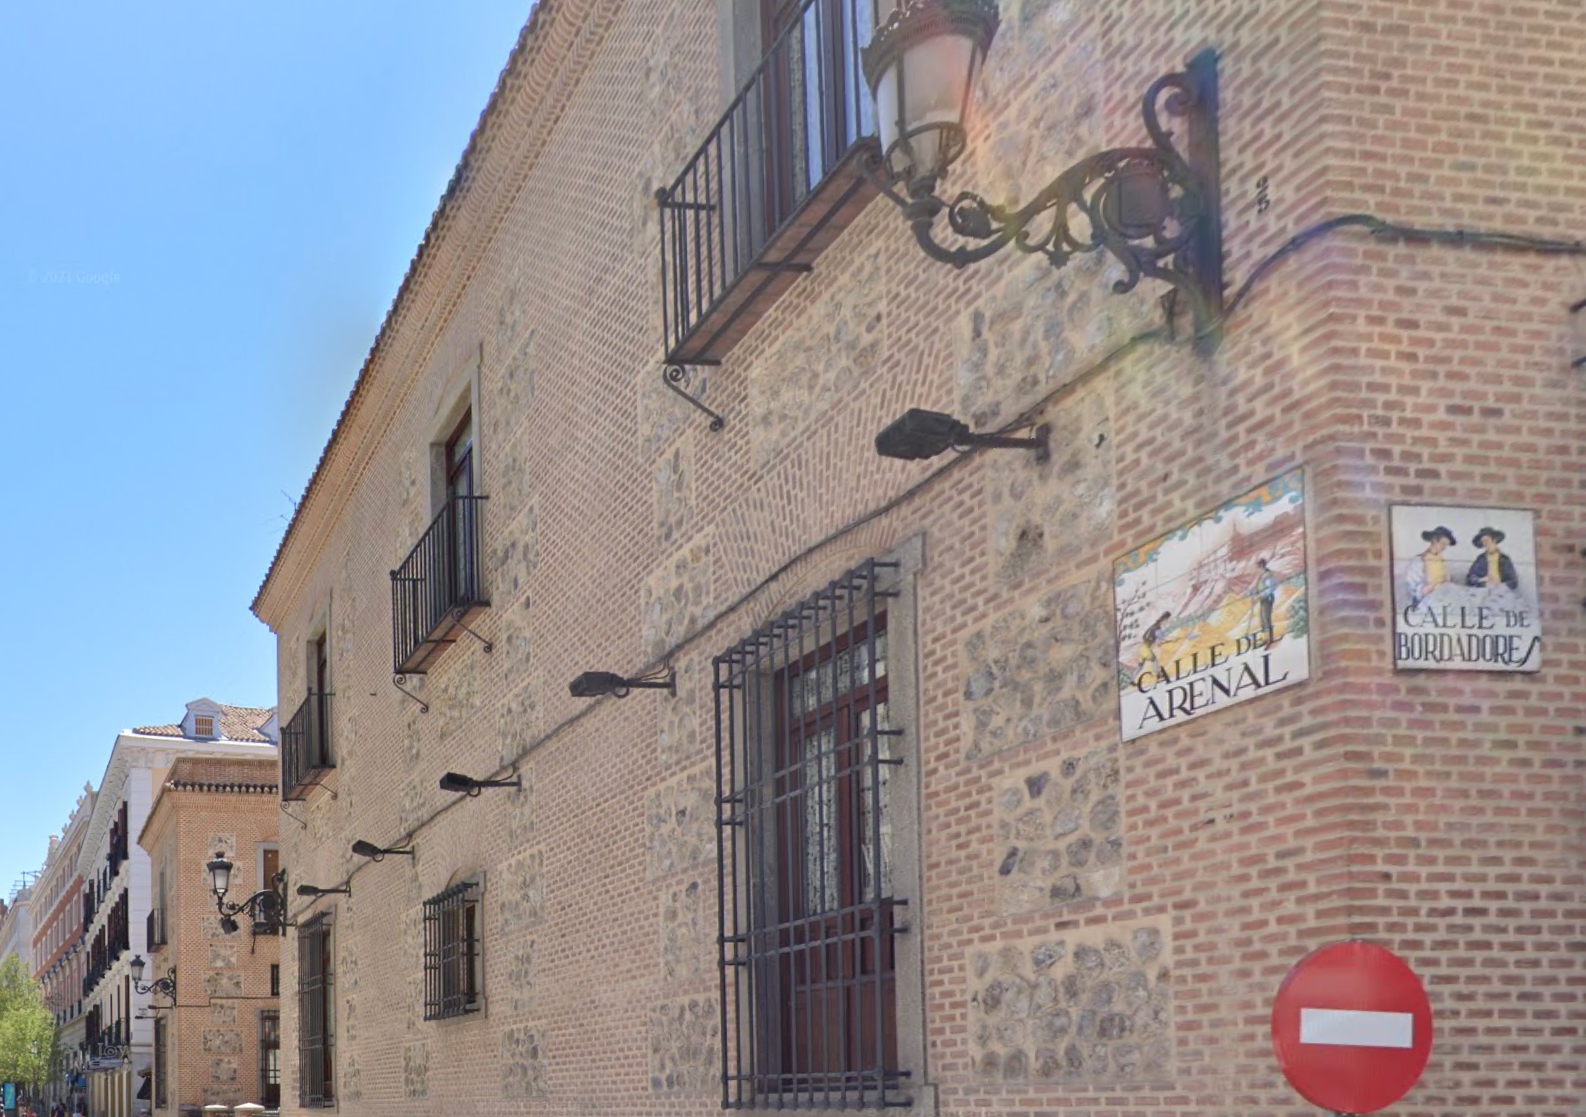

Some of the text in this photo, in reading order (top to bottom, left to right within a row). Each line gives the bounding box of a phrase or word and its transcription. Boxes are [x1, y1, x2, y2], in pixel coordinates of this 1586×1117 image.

[1403, 604, 1532, 630] CALLE DE
[1135, 624, 1284, 694] CALLE DEL
[1397, 632, 1541, 667] BORDADORES
[1137, 652, 1290, 730] ARENAL
